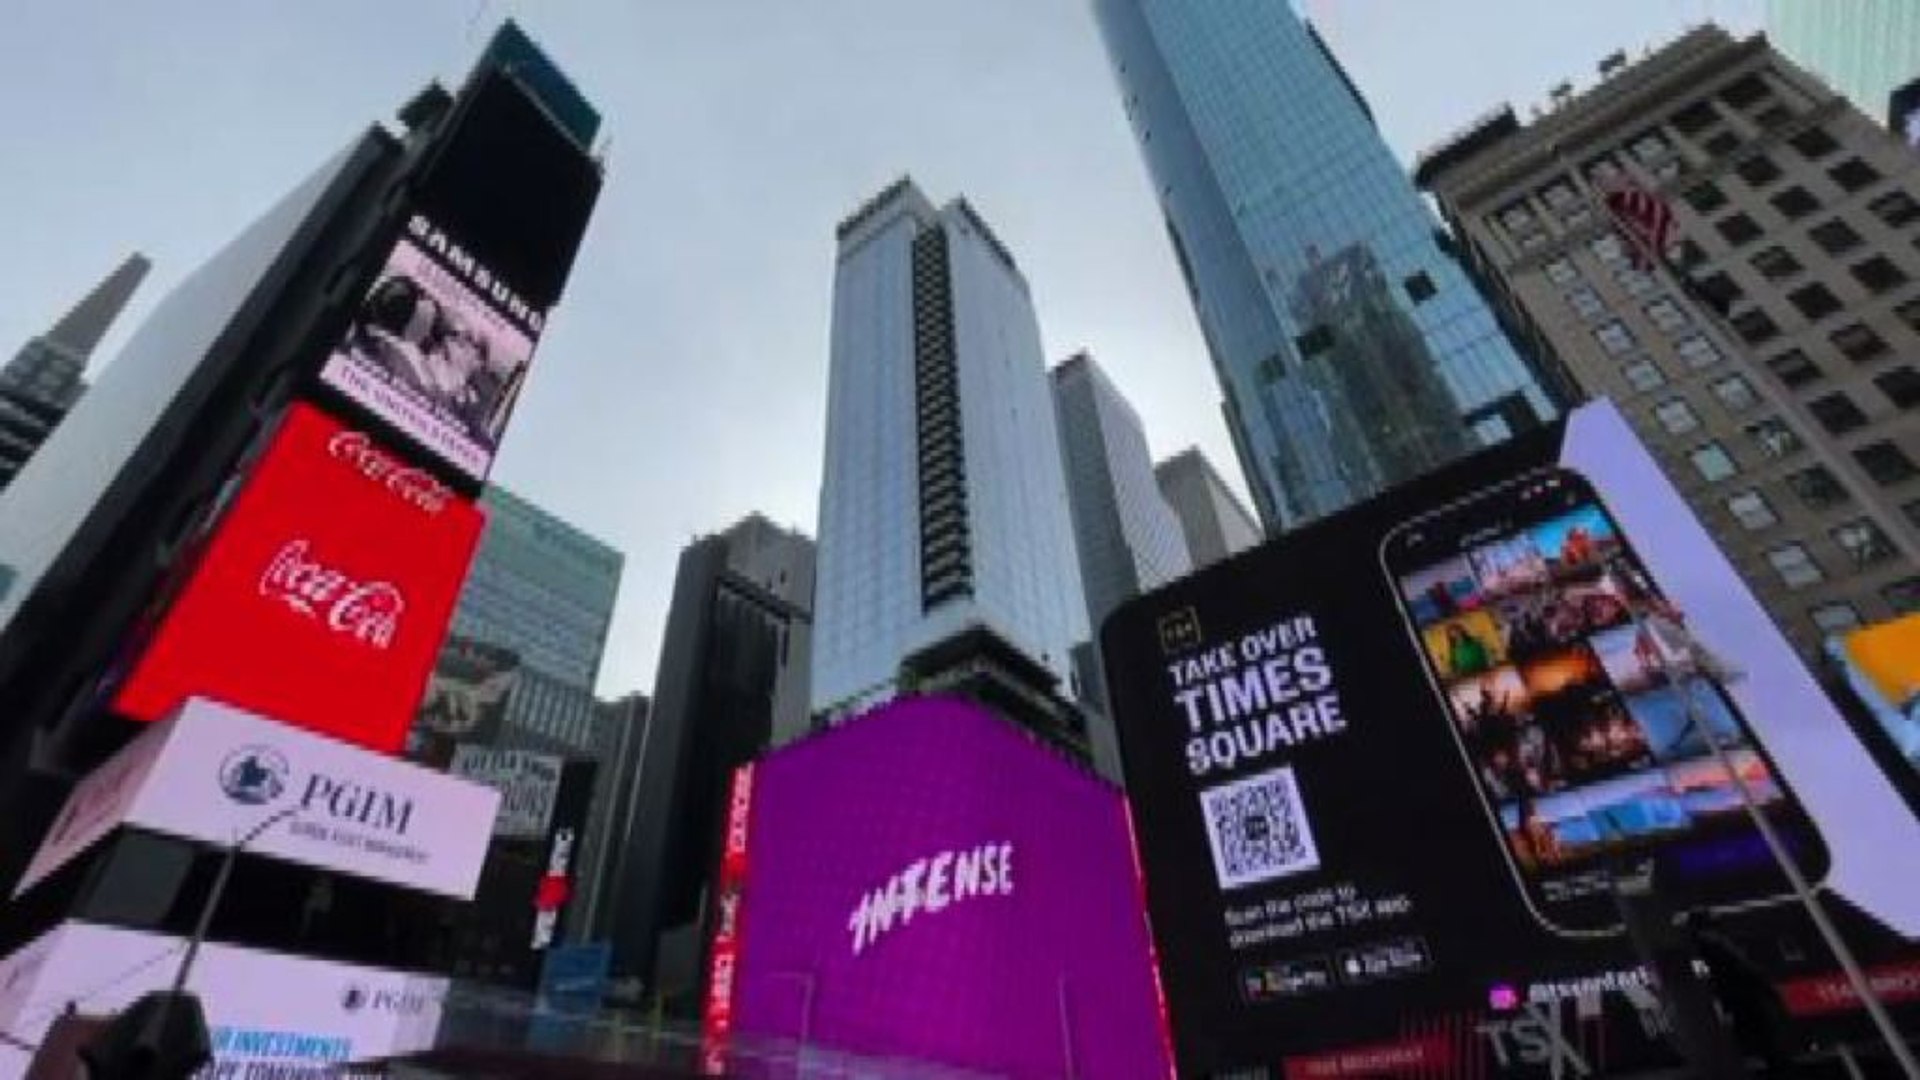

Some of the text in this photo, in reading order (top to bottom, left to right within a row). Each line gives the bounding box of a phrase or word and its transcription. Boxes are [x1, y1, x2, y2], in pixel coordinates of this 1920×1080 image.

[408, 214, 542, 333] SAMSUNG
[1168, 615, 1317, 688] TAKE OVER
[1174, 645, 1333, 732] TIMES
[1185, 694, 1347, 777] SQUARE
[300, 773, 414, 835] PGIM
[847, 840, 1014, 956] INTENSE
[1224, 903, 1264, 927] Scan
[1266, 899, 1292, 915] the
[1337, 884, 1357, 902] to
[232, 1030, 352, 1058] INVESTMENTS
